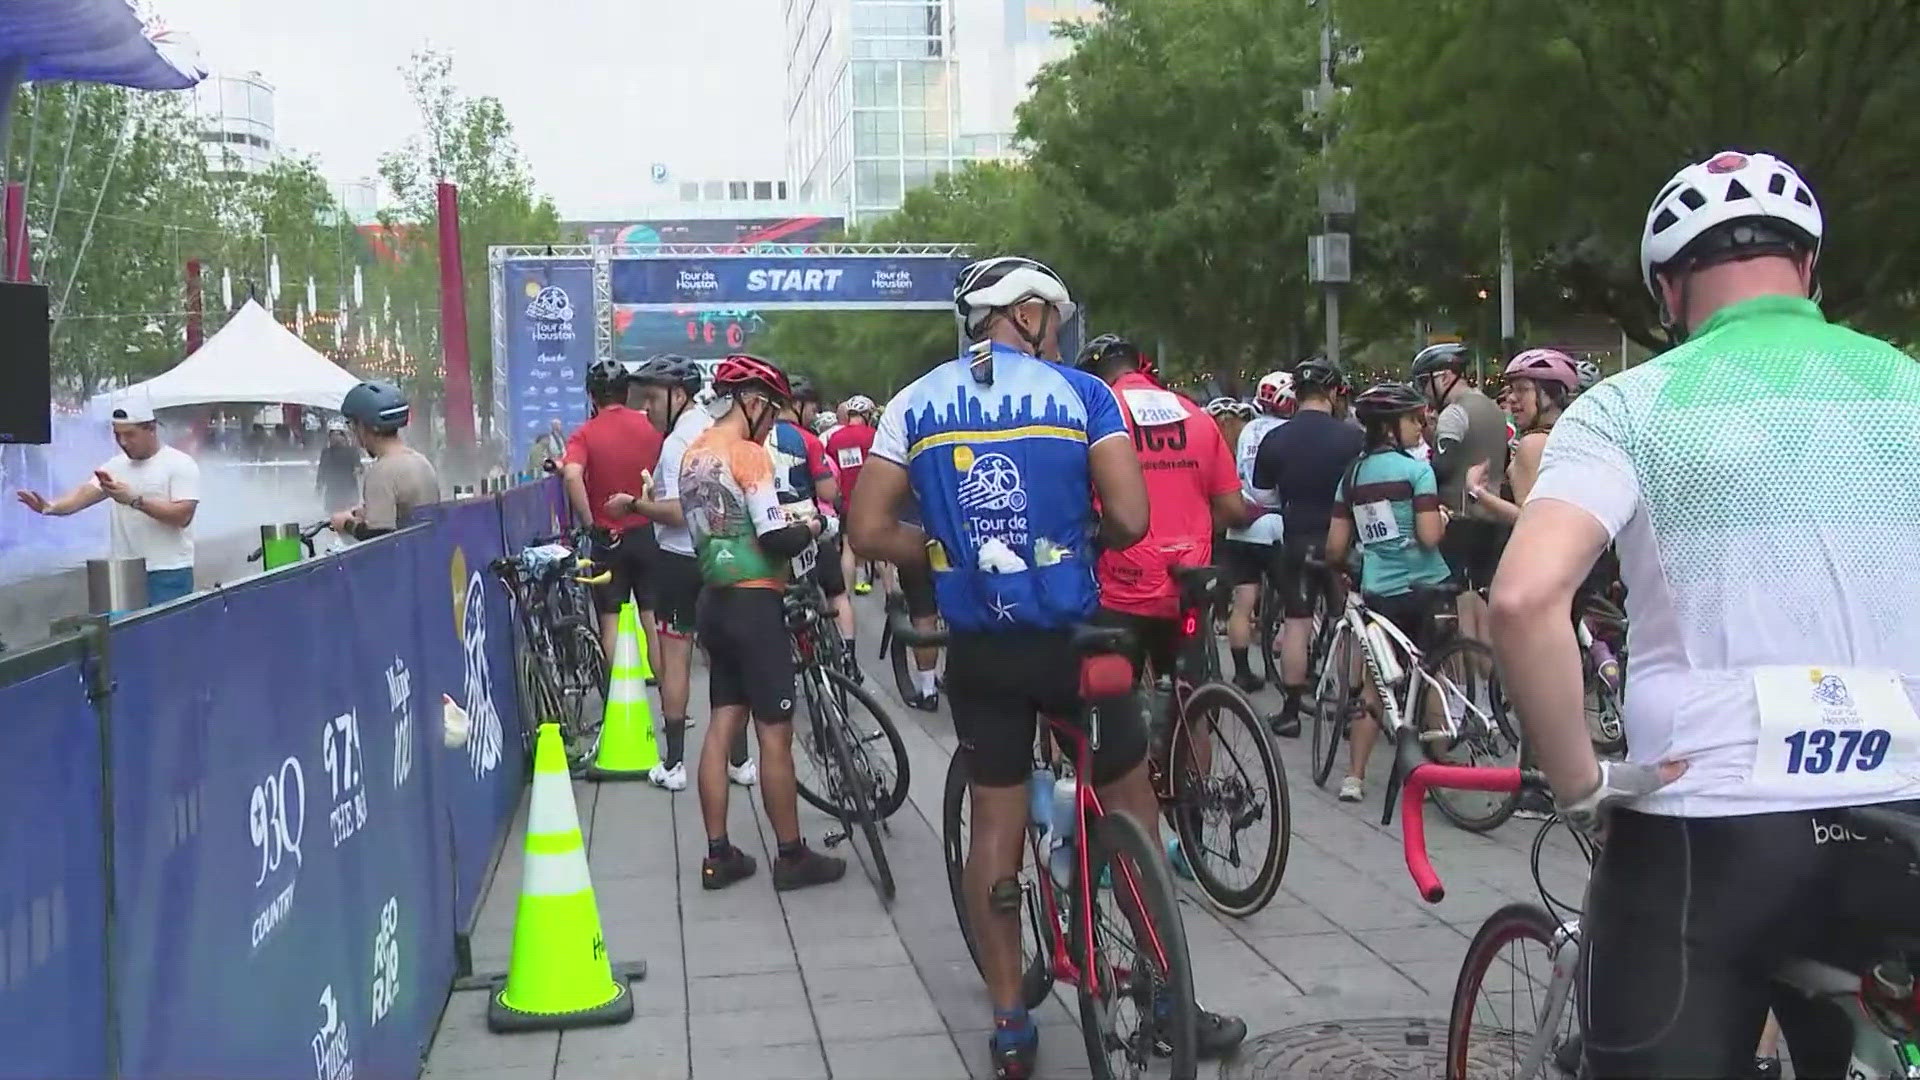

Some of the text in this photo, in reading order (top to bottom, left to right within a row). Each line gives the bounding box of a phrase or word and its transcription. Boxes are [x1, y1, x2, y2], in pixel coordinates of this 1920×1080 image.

[679, 270, 715, 281] Tour de
[747, 268, 843, 292] START
[874, 270, 910, 281] Tour de
[676, 280, 718, 291] Houston
[872, 280, 913, 290] Houston
[535, 321, 572, 332] Tour de
[532, 331, 576, 342] Houston
[970, 514, 1028, 532] Tour de
[1365, 520, 1388, 539] 316
[1784, 728, 1892, 775] 1379
[250, 755, 305, 888] 93Q
[252, 877, 296, 949] COUNTRY
